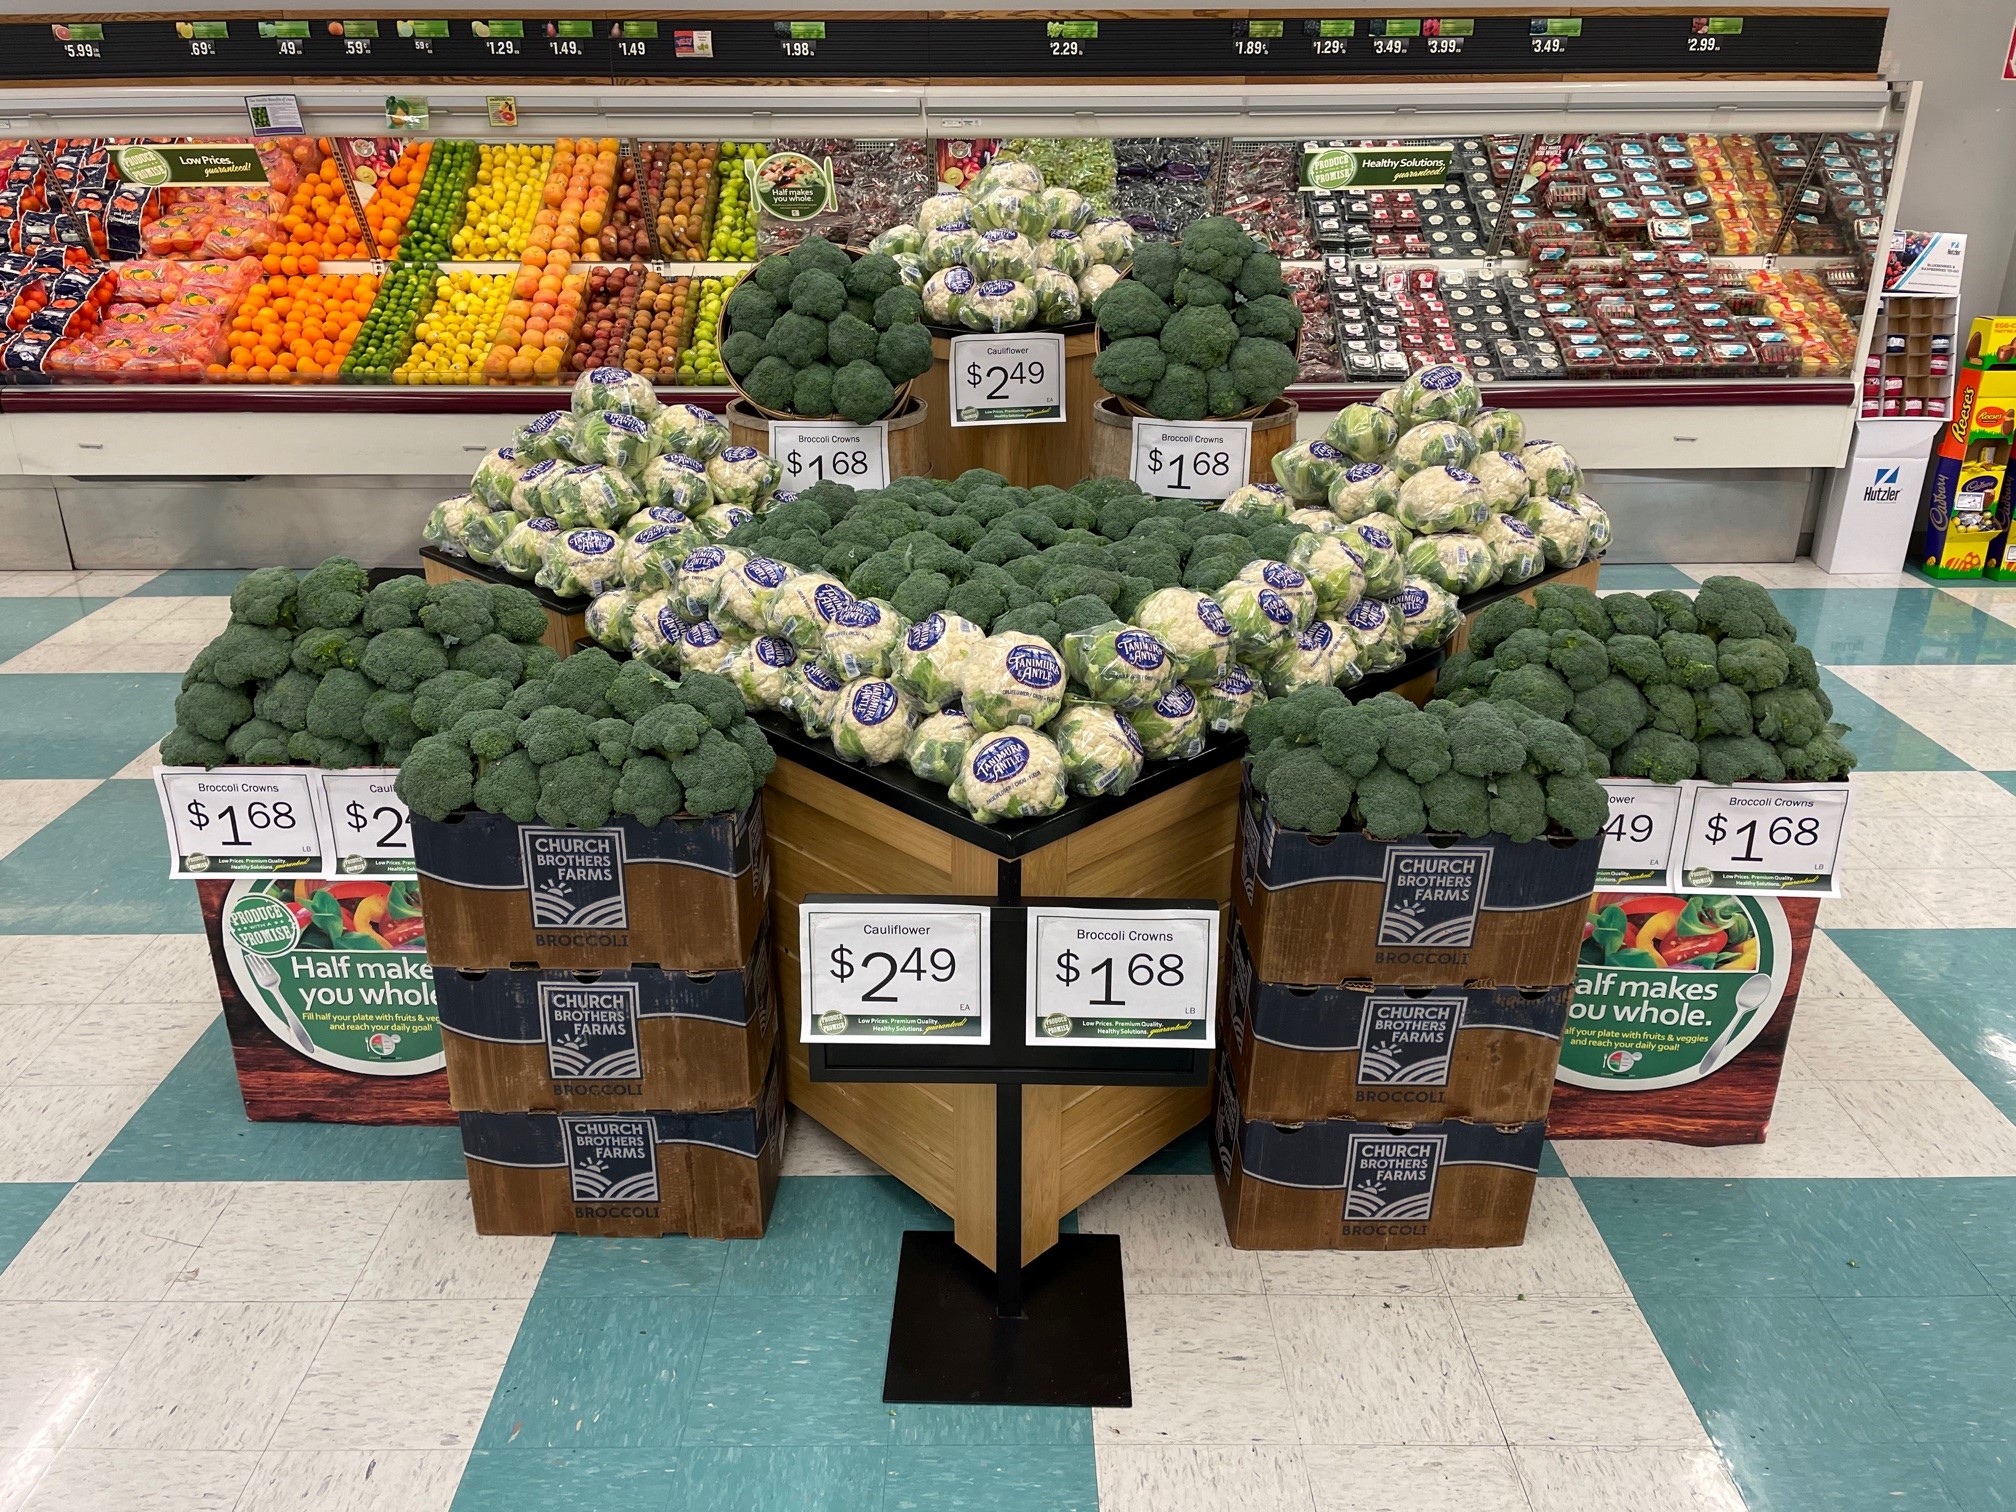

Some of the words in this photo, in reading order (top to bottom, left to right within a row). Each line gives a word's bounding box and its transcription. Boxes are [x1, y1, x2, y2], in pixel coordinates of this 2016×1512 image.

[278, 41, 296, 55] .49
[486, 41, 513, 55] $1.29
[549, 41, 576, 55] $1.49
[618, 42, 645, 56] $1.49
[782, 42, 809, 56] $1.98
[1050, 41, 1078, 55] $2.29
[1373, 40, 1401, 53] $3.49
[1428, 40, 1456, 53] $3.99
[1532, 38, 1560, 52] $3.49
[1687, 37, 1715, 52] $2.99
[123, 150, 156, 167] PRODUCE
[179, 156, 202, 165] Low
[202, 155, 234, 165] Prices.
[1314, 155, 1349, 170] PRODUCE
[1362, 158, 1399, 170] Healthy
[1400, 157, 1446, 168] Solutions.
[131, 165, 166, 180] PROMISE
[204, 163, 251, 178] guaranteed!
[1315, 169, 1351, 183] PROMISE
[1392, 167, 1445, 182] guaranteed!
[773, 196, 788, 204] you
[987, 347, 1029, 355] Cauliflower
[799, 435, 829, 443] Broccoli
[831, 435, 860, 443] Crowns
[1161, 434, 1193, 443] Broccoli
[1195, 435, 1224, 444] Crowns
[1863, 486, 1900, 501] Hutzler
[1930, 474, 1949, 531] Cadbury
[1009, 654, 1060, 675] TANIMURA
[976, 743, 1025, 777] TANIMURA
[198, 783, 239, 792] Broccoli
[241, 783, 279, 793] Crowns
[1609, 796, 1635, 804] ower
[1729, 797, 1772, 806] Broccoli
[1774, 798, 1815, 807] Crowns
[535, 838, 610, 853] CHURCH
[537, 855, 611, 867] BROTHERS
[1399, 859, 1476, 874] CHURCH
[558, 868, 613, 881] FARMS
[1397, 876, 1472, 887] BROTHERS
[1415, 889, 1470, 901] FARMS
[231, 905, 284, 925] PRODUCE
[239, 925, 291, 947] PROMISE
[863, 924, 930, 935] Cauliflower
[1077, 929, 1125, 941] Broccoli
[1128, 930, 1173, 942] Crowns
[535, 934, 629, 947] BROCCOLI
[1375, 952, 1470, 965] BROCCOLI
[290, 956, 351, 979] Half
[357, 956, 434, 980] make
[1575, 972, 1618, 996] alf
[1619, 975, 1719, 1001] makes
[299, 987, 354, 1012] you
[553, 994, 624, 1009] CHURCH
[959, 1003, 970, 1011] EA
[1377, 1007, 1451, 1020] CHURCH
[1568, 1002, 1604, 1020] ou
[1613, 1000, 1713, 1026] whole.
[315, 1013, 331, 1021] half
[332, 1014, 351, 1023] your
[352, 1013, 374, 1023] plate
[375, 1013, 394, 1022] with
[395, 1014, 417, 1022] fruits
[417, 1014, 425, 1022] &
[554, 1010, 625, 1022] BROTHERS
[329, 1023, 341, 1031] and
[342, 1023, 370, 1031] reach
[371, 1024, 390, 1033] your
[391, 1024, 411, 1033] daily
[412, 1024, 433, 1033] goal!
[574, 1023, 627, 1036] FARMS
[873, 1025, 895, 1033] Healthy
[1375, 1020, 1446, 1031] BROTHERS
[1391, 1032, 1444, 1043] FARMS
[1564, 1027, 1576, 1036] alf
[1576, 1029, 1596, 1039] your
[1597, 1029, 1620, 1039] plate
[1621, 1030, 1642, 1040] with
[1642, 1032, 1666, 1041] fruits
[1676, 1035, 1709, 1044] veggies
[1570, 1038, 1588, 1046] and
[1588, 1038, 1613, 1047] reach
[1614, 1041, 1635, 1050] your
[1635, 1040, 1656, 1051] daily
[1657, 1042, 1680, 1051] goal!
[553, 1084, 643, 1096] BROCCOLI
[1356, 1091, 1446, 1103] BROCCOLI
[574, 1123, 643, 1135] CHURCH
[576, 1137, 644, 1147] BROTHERS
[595, 1148, 646, 1159] FARMS
[1362, 1145, 1431, 1158] CHURCH
[1360, 1159, 1428, 1169] BROTHERS
[1376, 1170, 1427, 1181] FARMS
[575, 1207, 660, 1218] BROCCOLI
[1342, 1225, 1427, 1236] BROCCOLI
